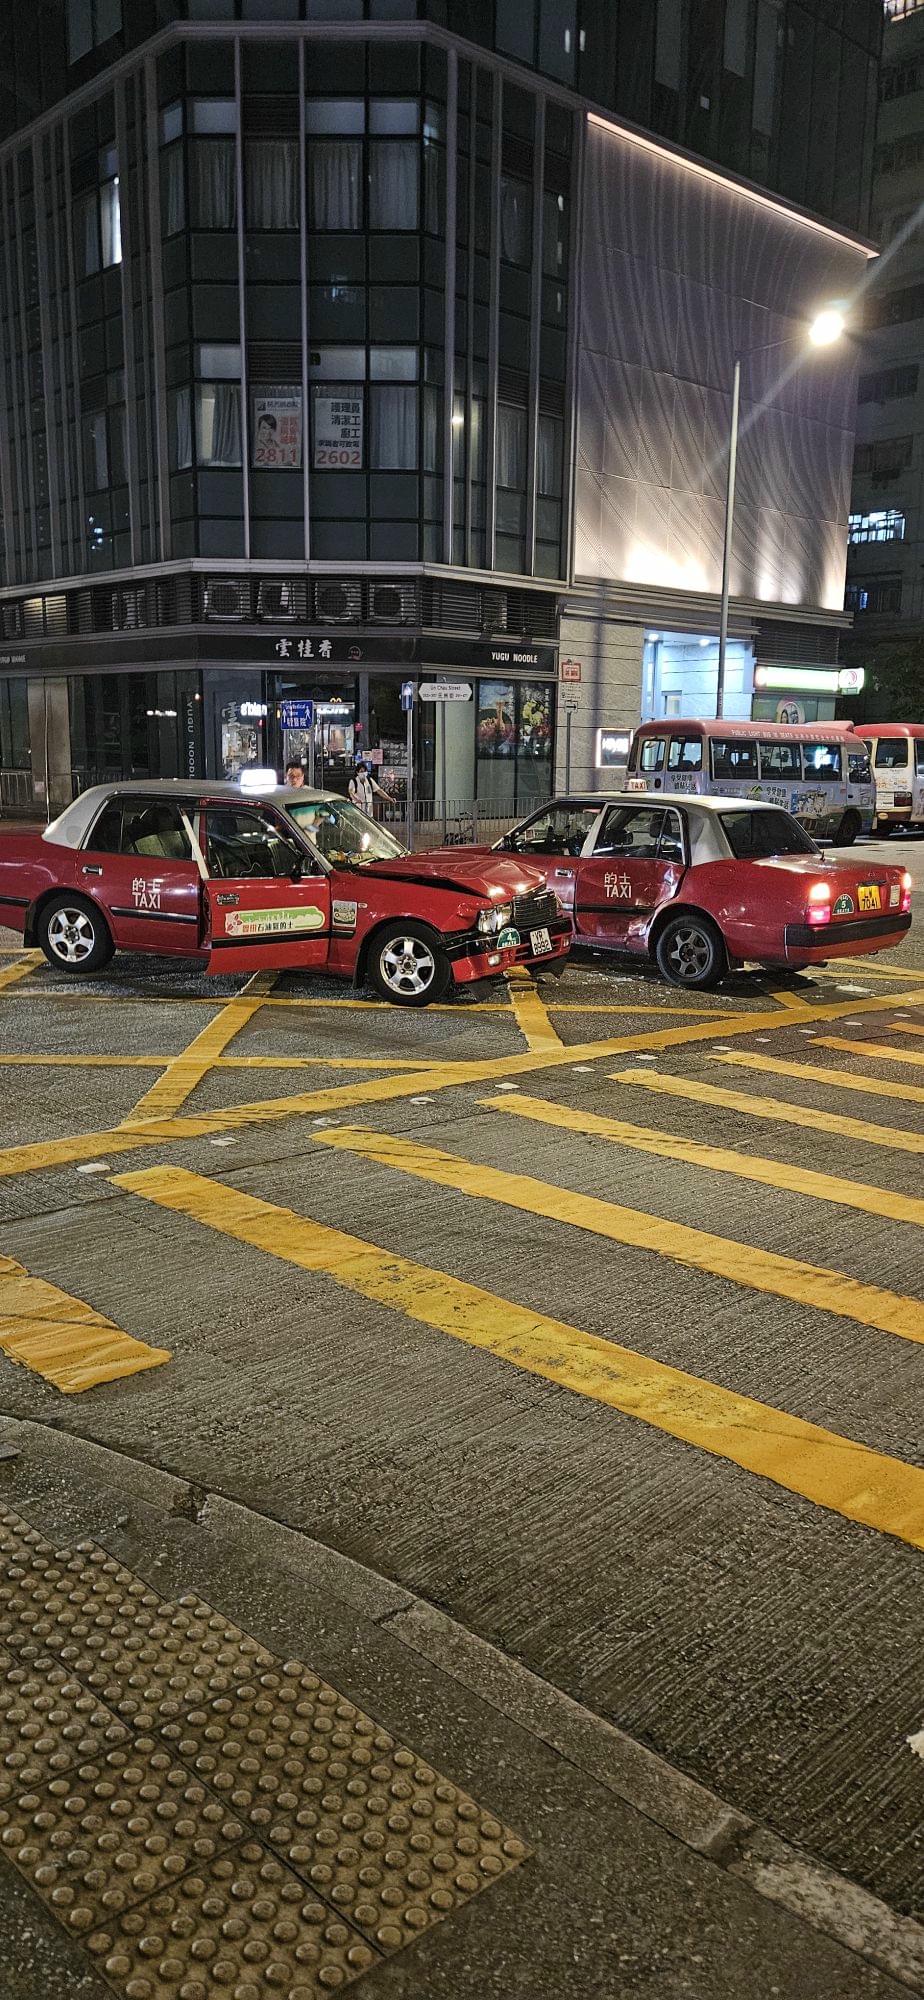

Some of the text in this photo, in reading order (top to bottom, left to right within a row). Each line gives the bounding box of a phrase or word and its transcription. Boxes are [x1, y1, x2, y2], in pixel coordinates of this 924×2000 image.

[256, 448, 296, 462] 2811
[317, 450, 360, 464] 2602
[275, 638, 332, 659] 雲桂香
[491, 652, 538, 663] YUGU NOODLE
[186, 701, 194, 733] YUGU
[631, 781, 646, 790] TAXI
[132, 877, 161, 893] 的士
[604, 872, 631, 885] 的士
[604, 884, 632, 898] TAXI
[132, 892, 160, 909] TAXI
[841, 901, 846, 909] 5
